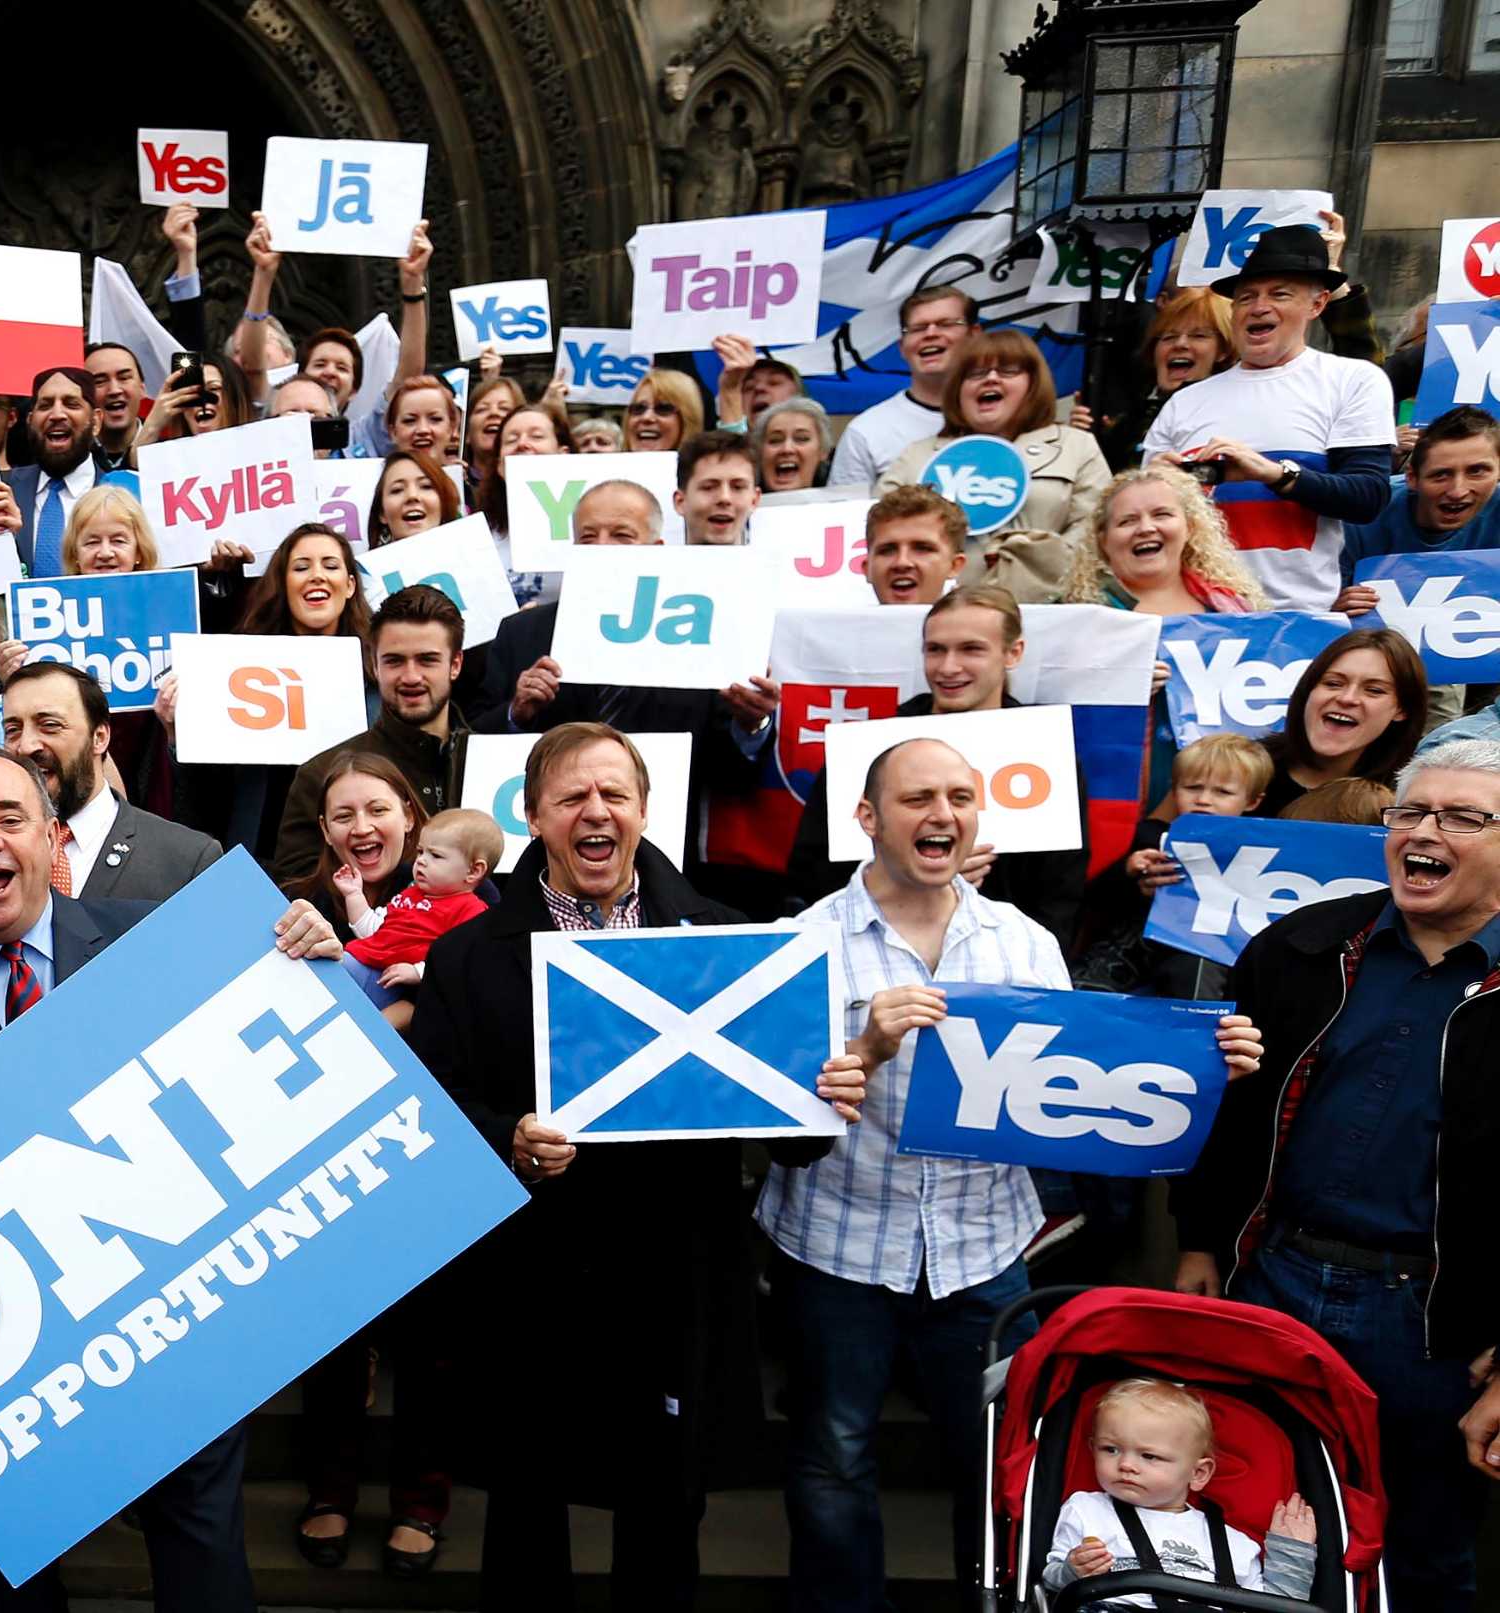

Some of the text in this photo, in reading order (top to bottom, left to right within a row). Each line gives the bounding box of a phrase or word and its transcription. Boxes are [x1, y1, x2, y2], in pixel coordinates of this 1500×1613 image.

[141, 141, 227, 194] Yes
[298, 159, 374, 231] Jā
[1203, 207, 1322, 268] Ye
[457, 296, 548, 340] Yes
[650, 250, 799, 320] Taip
[564, 341, 650, 390] Yes
[162, 460, 295, 530] Kyllä
[935, 465, 1018, 507] Yes
[17, 586, 104, 642] Bu
[600, 576, 714, 645] Ja
[1361, 576, 1500, 658] Ye
[227, 666, 307, 730] Sì
[1163, 639, 1314, 726] Ye
[935, 1016, 1197, 1146] Yes
